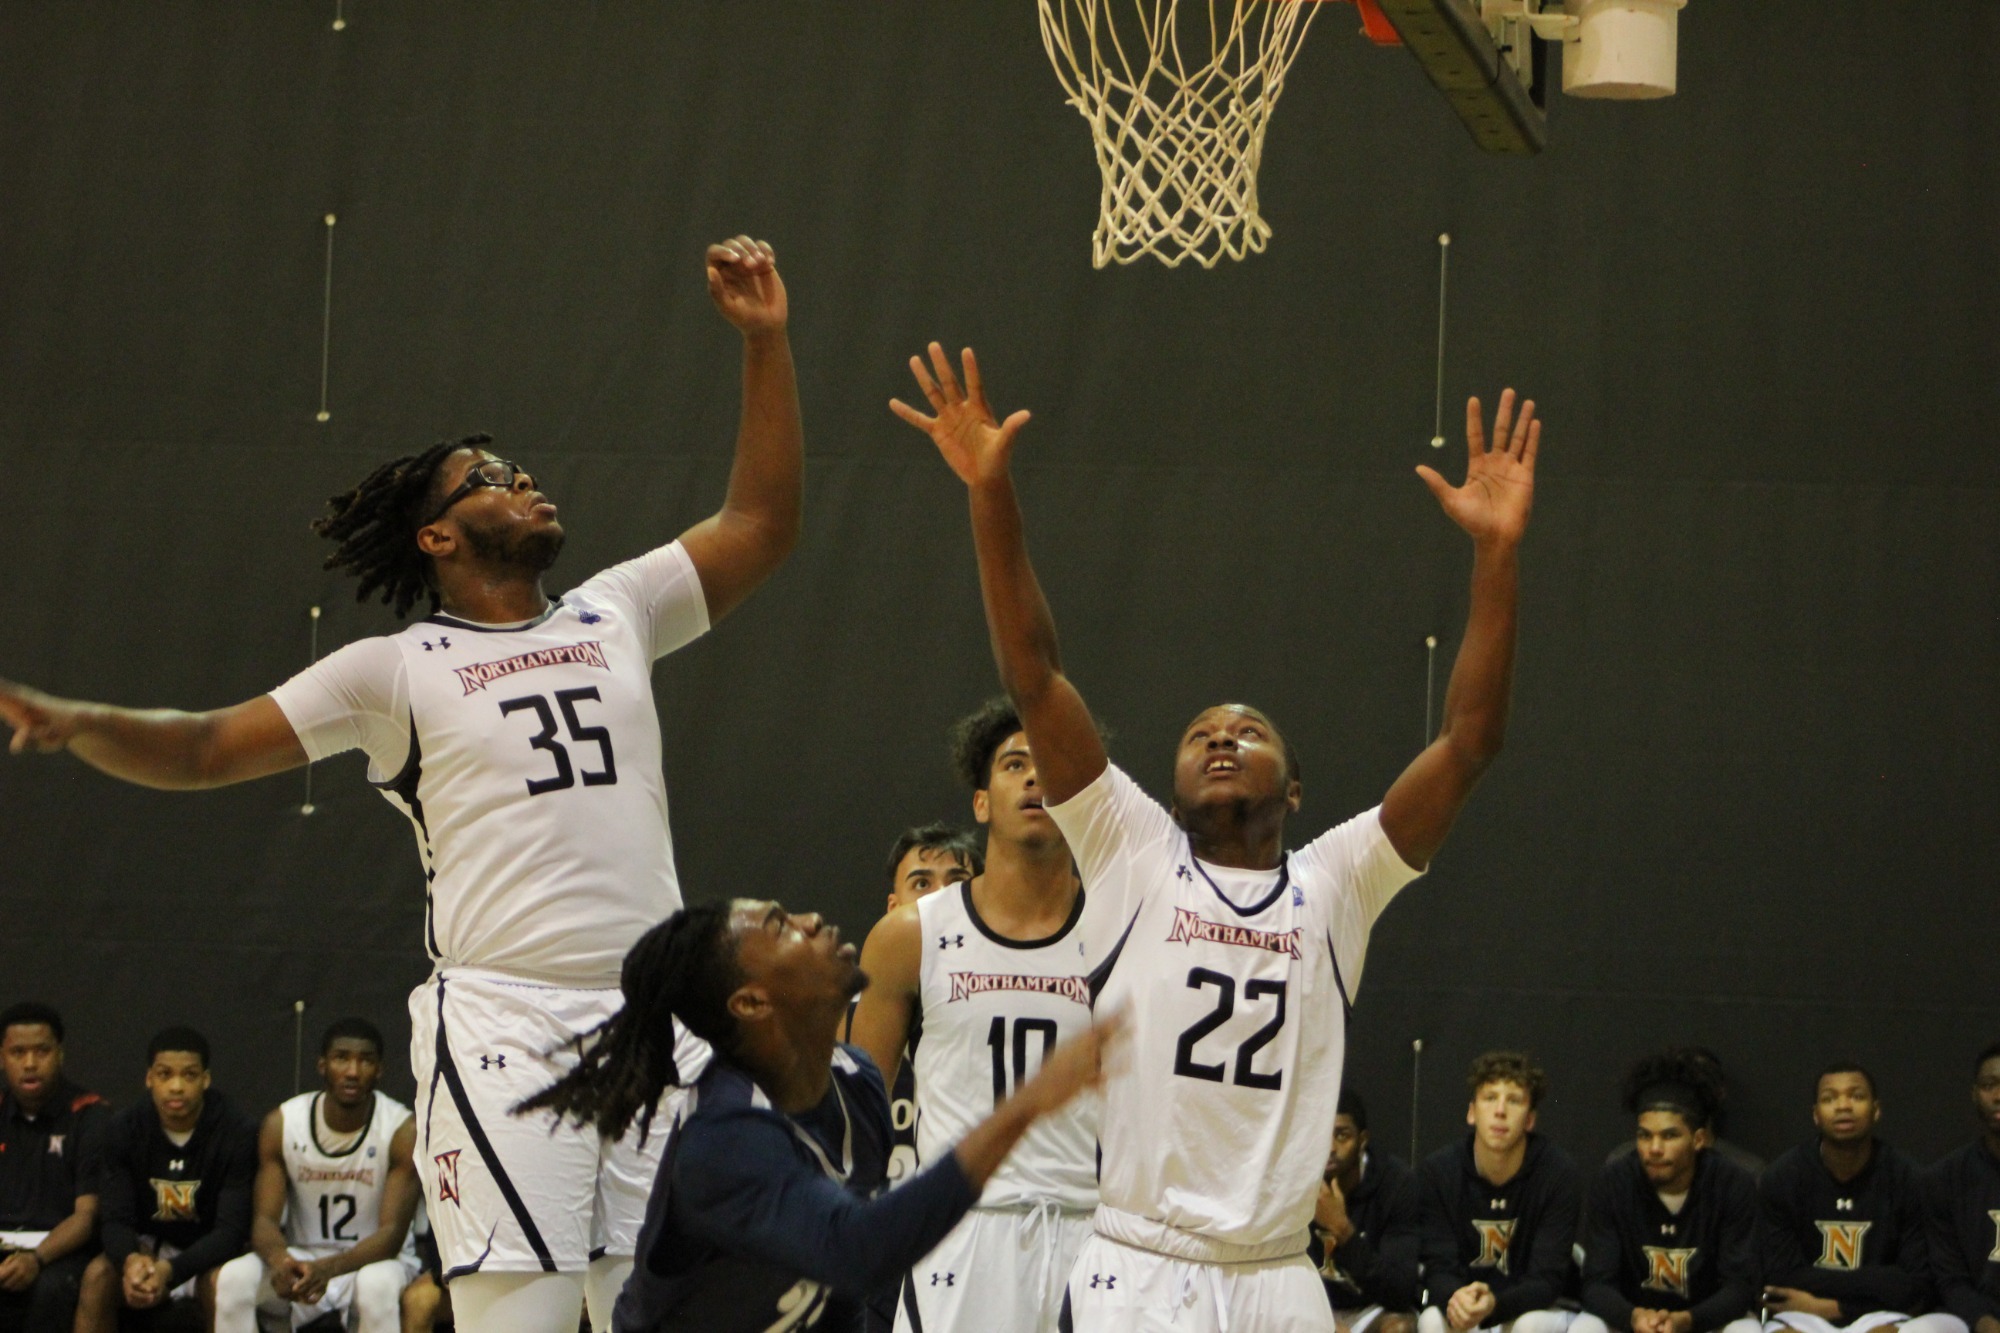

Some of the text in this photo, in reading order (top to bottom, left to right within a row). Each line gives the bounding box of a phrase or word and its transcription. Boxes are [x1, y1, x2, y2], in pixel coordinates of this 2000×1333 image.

[452, 640, 611, 696] NORTHAMPTON
[498, 686, 618, 796] 35
[947, 971, 1092, 1004] NORTHAMPTON
[1173, 966, 1287, 1091] 22
[149, 1178, 201, 1222] N
[434, 1149, 463, 1210] N
[318, 1194, 359, 1241] 12
[1813, 1220, 1872, 1270] N
[1469, 1217, 1518, 1276] N
[1640, 1245, 1698, 1299] N
